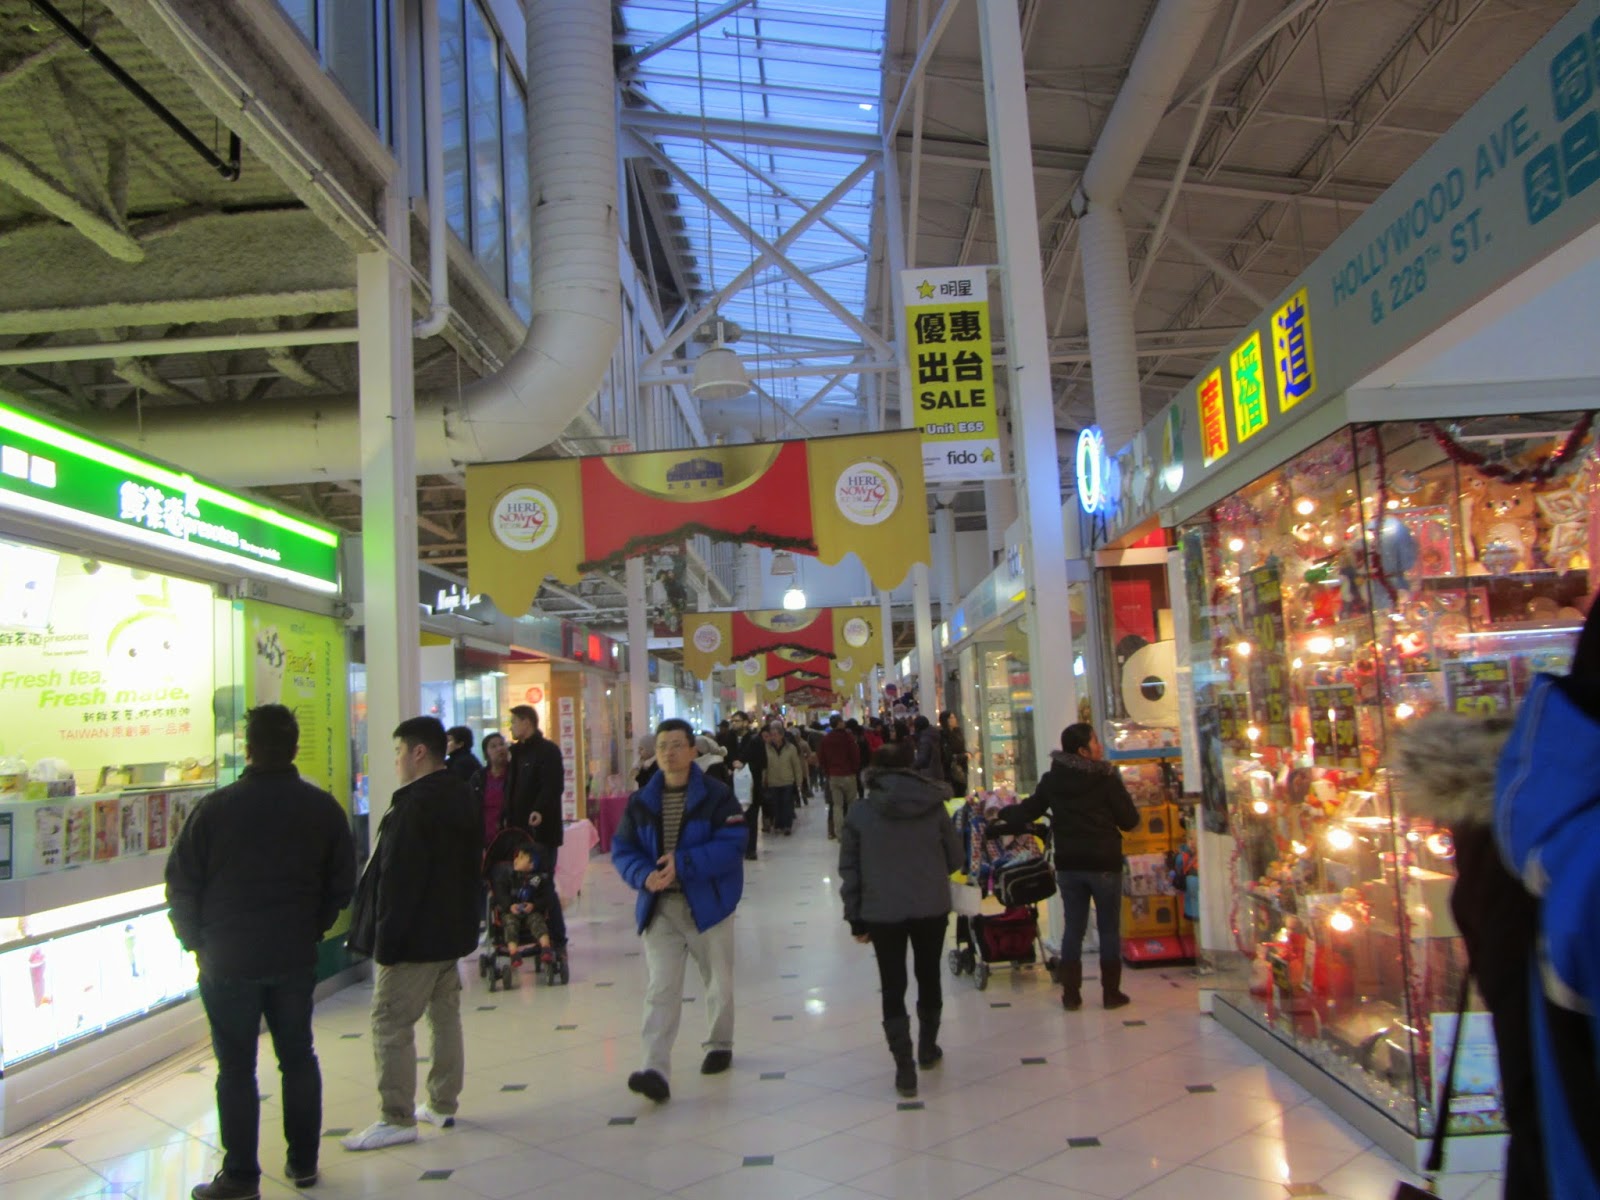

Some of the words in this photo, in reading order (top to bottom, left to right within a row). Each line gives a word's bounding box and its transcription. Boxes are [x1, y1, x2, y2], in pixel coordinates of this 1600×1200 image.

[1332, 167, 1465, 306] HOLLYWOOD
[1475, 105, 1540, 190] AVE.
[1371, 289, 1384, 325] &
[1451, 207, 1492, 264] ST.
[940, 280, 973, 297] 明星
[914, 310, 982, 344] 優惠
[918, 351, 984, 384] 出台
[920, 389, 987, 411] SALE
[926, 423, 955, 435] Unit
[958, 422, 984, 433] E65
[947, 450, 978, 464] fido
[848, 475, 879, 485] HERE
[840, 485, 867, 496] NOW
[507, 502, 538, 513] HERE
[499, 512, 526, 523] NOW
[0, 669, 62, 689] Fresh
[70, 669, 107, 686] tea.
[38, 688, 107, 709] Fresh
[59, 729, 109, 741] TAIWAN
